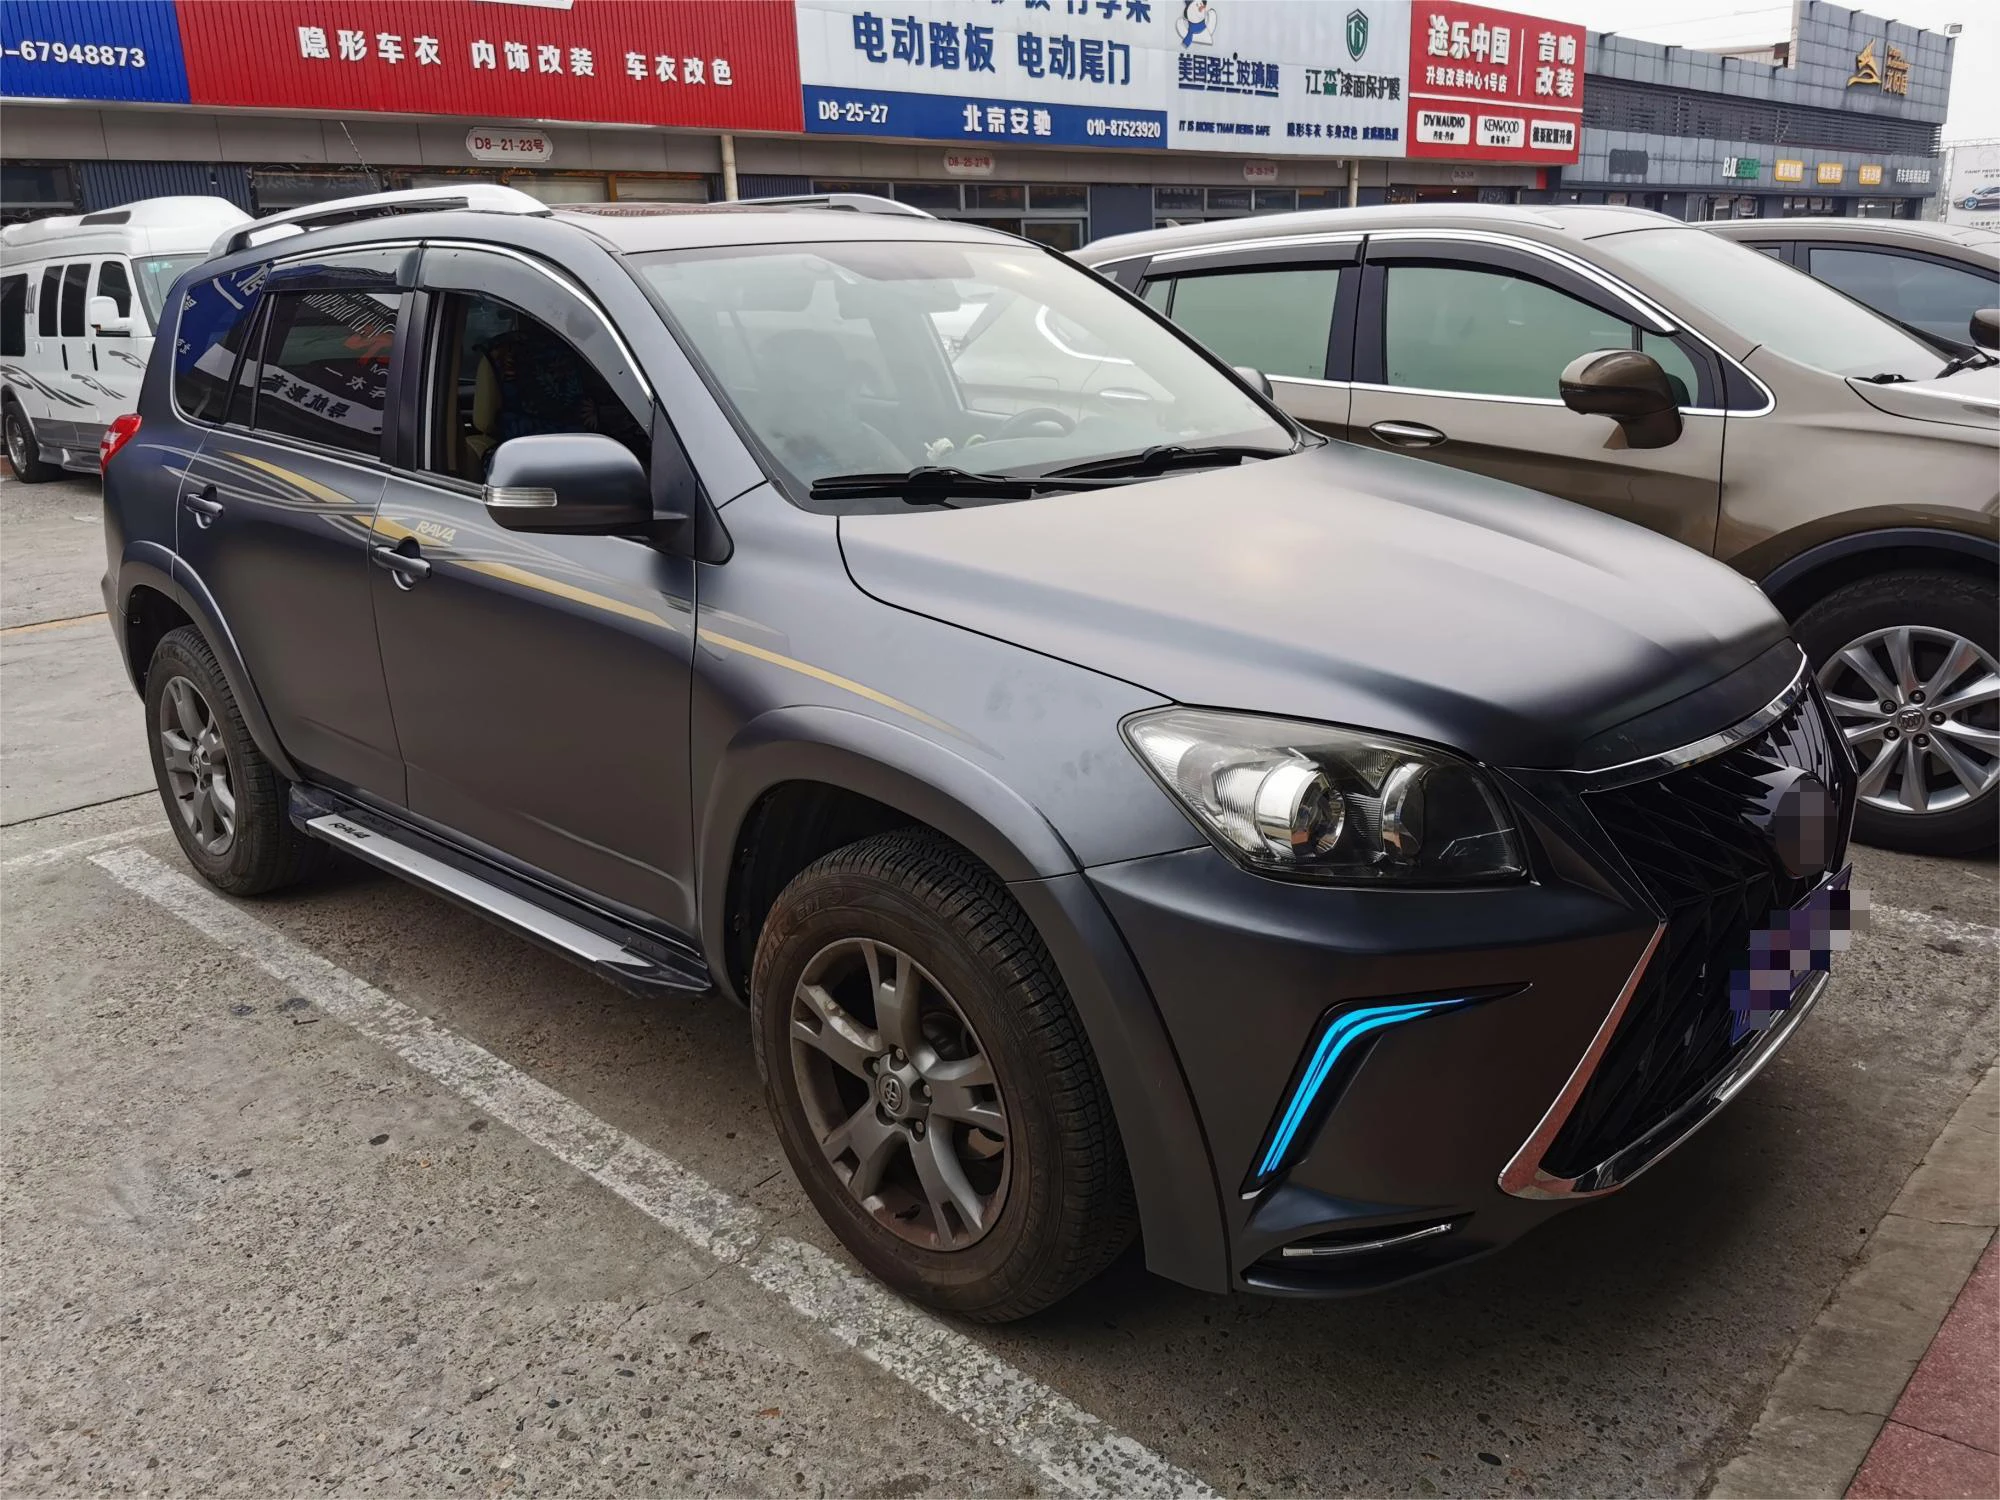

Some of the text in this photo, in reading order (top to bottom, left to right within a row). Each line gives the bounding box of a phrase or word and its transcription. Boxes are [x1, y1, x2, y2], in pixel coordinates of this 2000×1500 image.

[852, 11, 1131, 86] 电动踏板 电动尾门
[1427, 13, 1511, 65] 途乐中国
[1538, 31, 1577, 66] 音响
[0, 40, 146, 69] -67948873
[298, 26, 734, 86] 隐形车衣 内饰改装 车衣改色
[1425, 66, 1508, 94] 升级改装中心1号店
[1536, 66, 1575, 98] 改装
[818, 100, 889, 124] D8-25-27
[962, 104, 1052, 136] 北京安驰
[1424, 114, 1465, 129] DYNAUDIO
[1086, 119, 1161, 139] 010-87523920
[1179, 120, 1187, 131] IT
[1188, 120, 1195, 131] IS
[1216, 122, 1234, 134] THAN
[1255, 125, 1271, 136] SAFE
[1484, 119, 1520, 134] KENWOOD
[474, 136, 544, 153] D8-21-23号
[416, 520, 456, 541] RAV4
